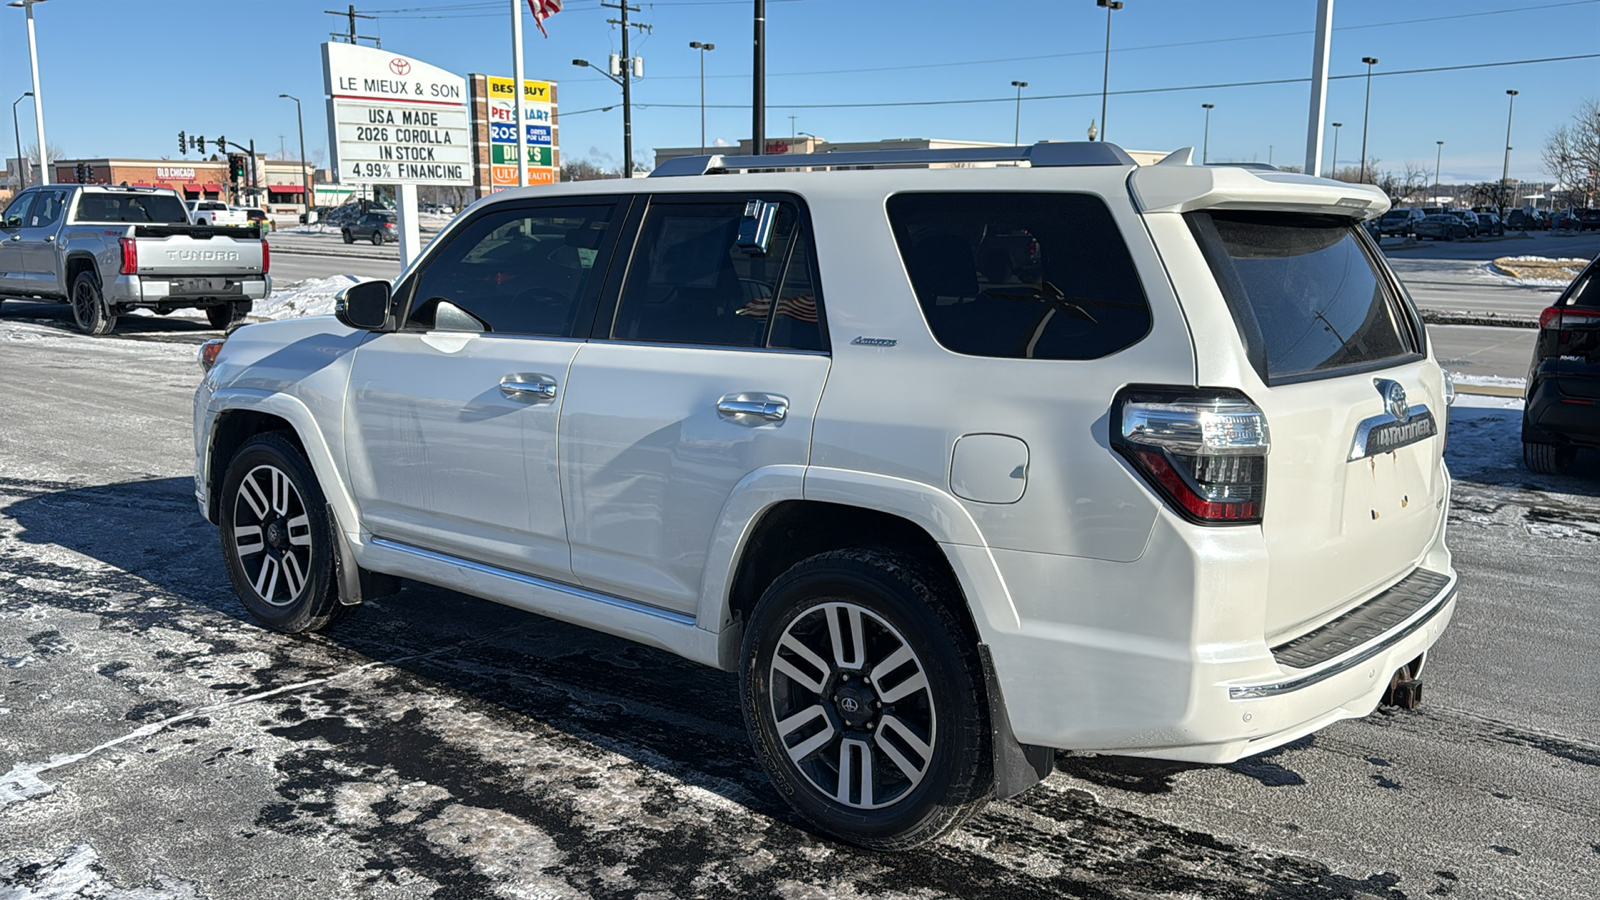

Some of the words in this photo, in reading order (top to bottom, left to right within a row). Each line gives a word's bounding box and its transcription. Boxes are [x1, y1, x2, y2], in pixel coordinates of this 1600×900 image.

[340, 77, 358, 91] LE
[364, 79, 408, 94] MIEUX
[414, 82, 424, 95] &
[430, 83, 459, 98] SON
[492, 83, 515, 94] BES
[524, 86, 546, 96] BUY
[368, 109, 394, 124] USA
[402, 111, 438, 126] MADE
[357, 127, 389, 142] 2026
[395, 129, 452, 144] COROLLA
[491, 127, 518, 139] ROS
[379, 145, 393, 160] IN
[396, 146, 435, 161] STOCK
[503, 145, 541, 161] DI'S
[157, 168, 169, 177] OLD
[170, 168, 195, 178] CHICAGO
[352, 162, 391, 178] 4.99%
[398, 163, 462, 179] FINANCING
[528, 171, 552, 180] EAUTY
[166, 250, 240, 261] TUNDRA
[1377, 419, 1430, 446] 4RUNNER
